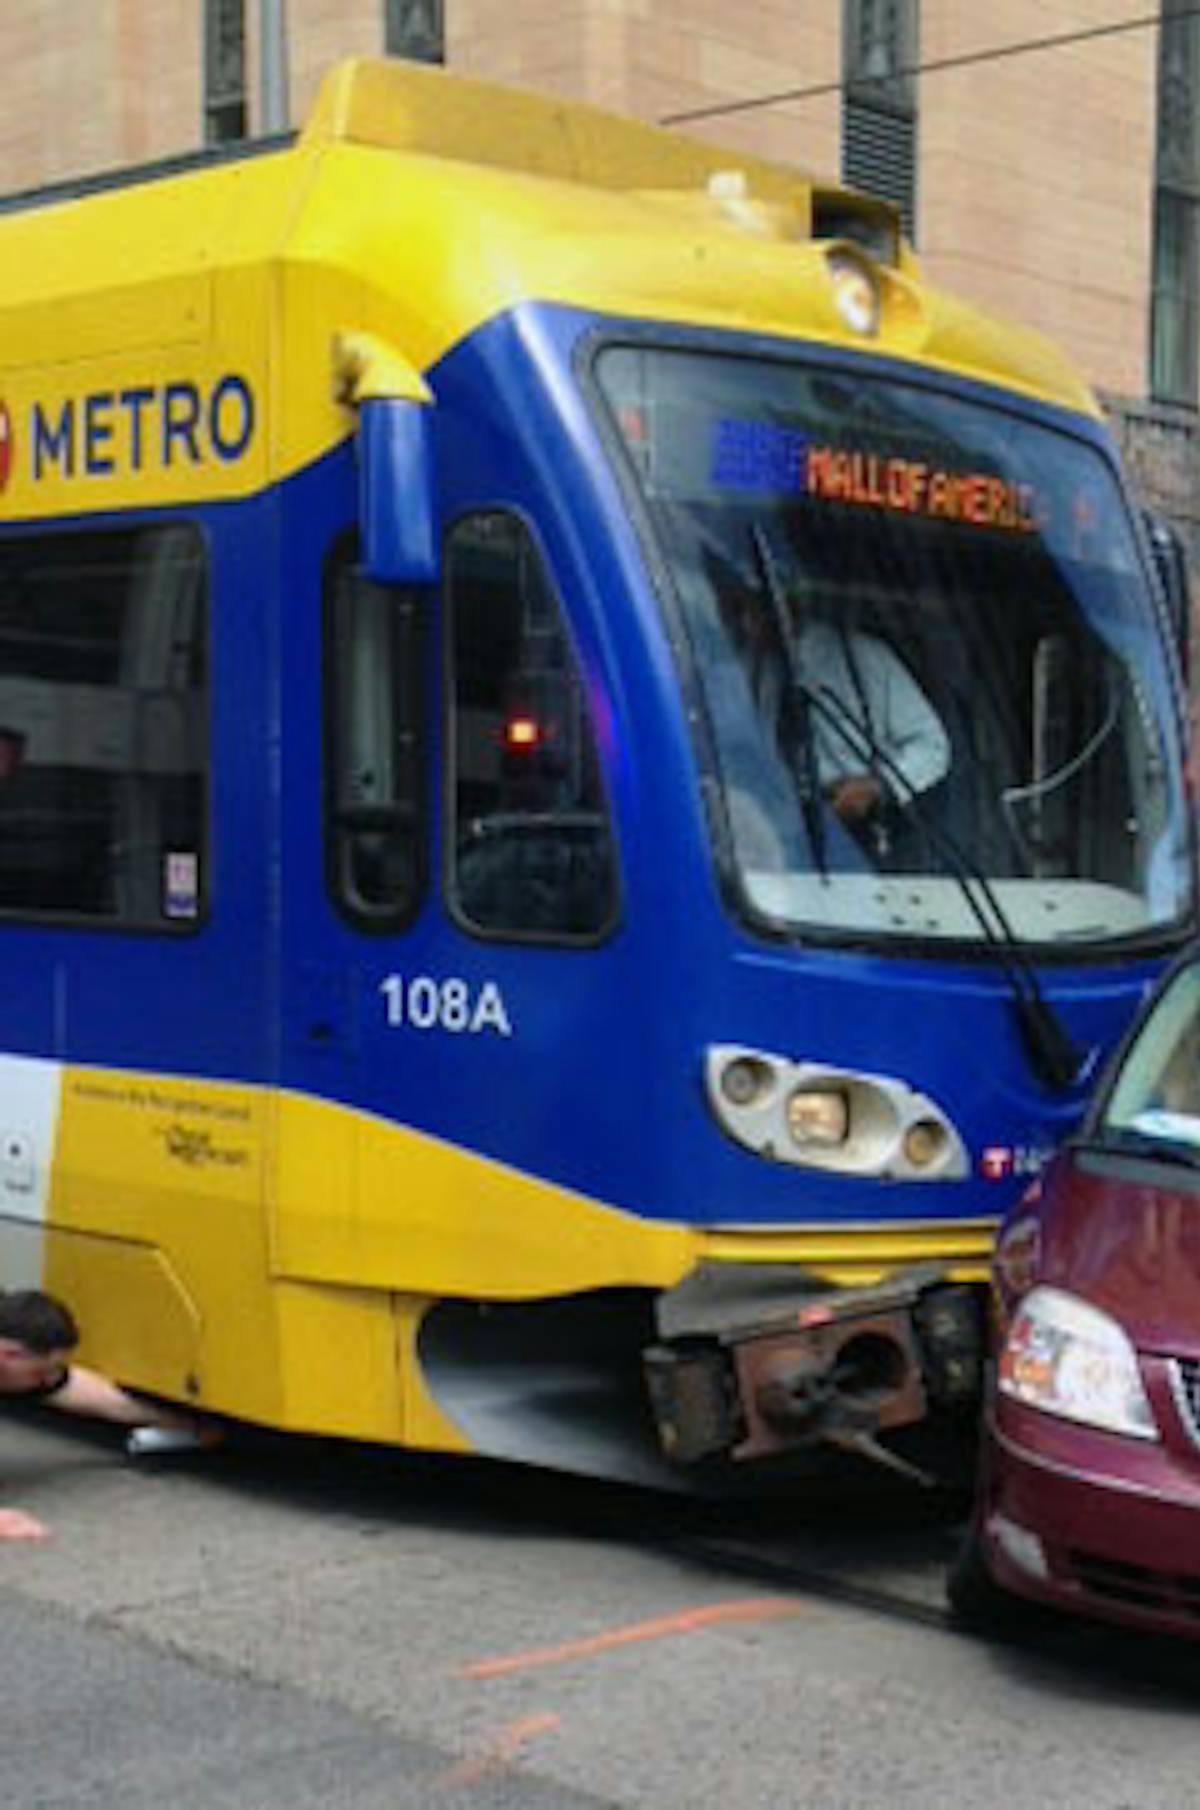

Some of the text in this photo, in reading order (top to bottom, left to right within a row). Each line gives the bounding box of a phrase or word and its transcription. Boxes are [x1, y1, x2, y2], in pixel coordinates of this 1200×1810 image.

[31, 374, 255, 481] METRO
[807, 444, 882, 504] MALL
[887, 456, 927, 512] OF
[378, 972, 513, 1037] 108A
